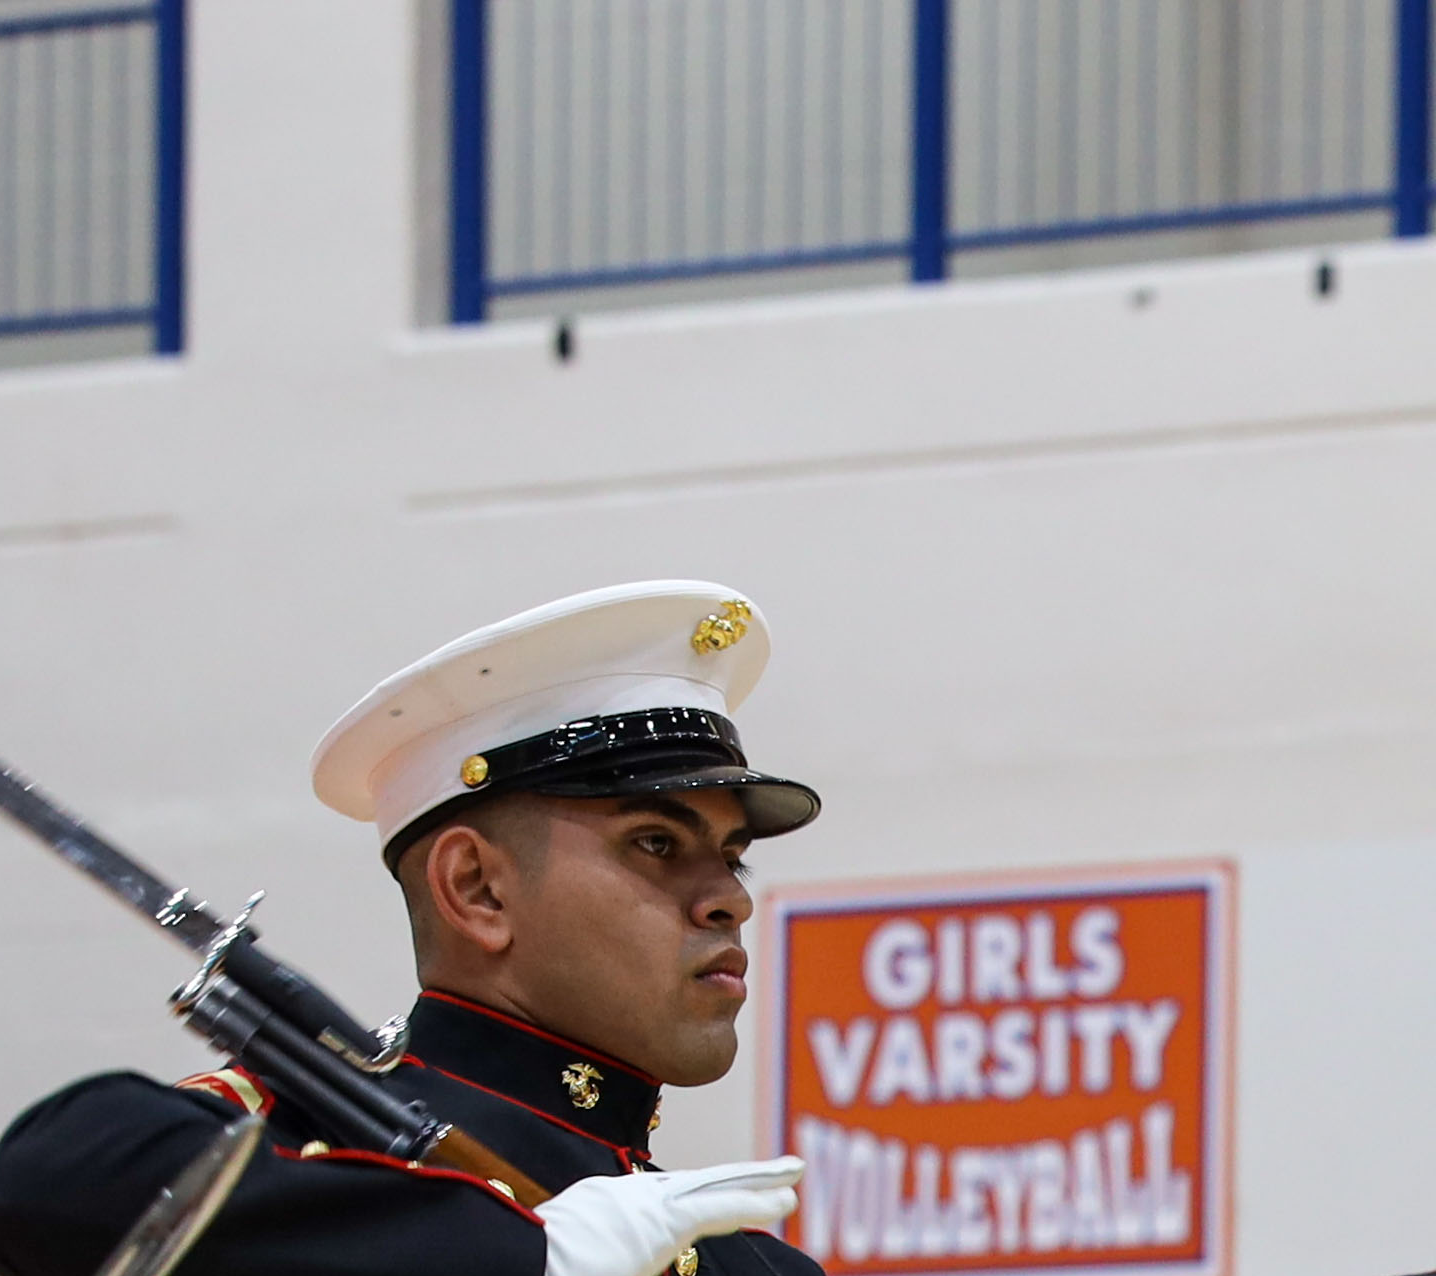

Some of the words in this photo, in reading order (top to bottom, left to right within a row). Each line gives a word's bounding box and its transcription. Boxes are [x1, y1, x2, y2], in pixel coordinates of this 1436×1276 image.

[863, 905, 1126, 1009] GIRLS
[807, 998, 1180, 1107] VARSITY
[795, 1102, 1191, 1264] VOLLEYBALL
